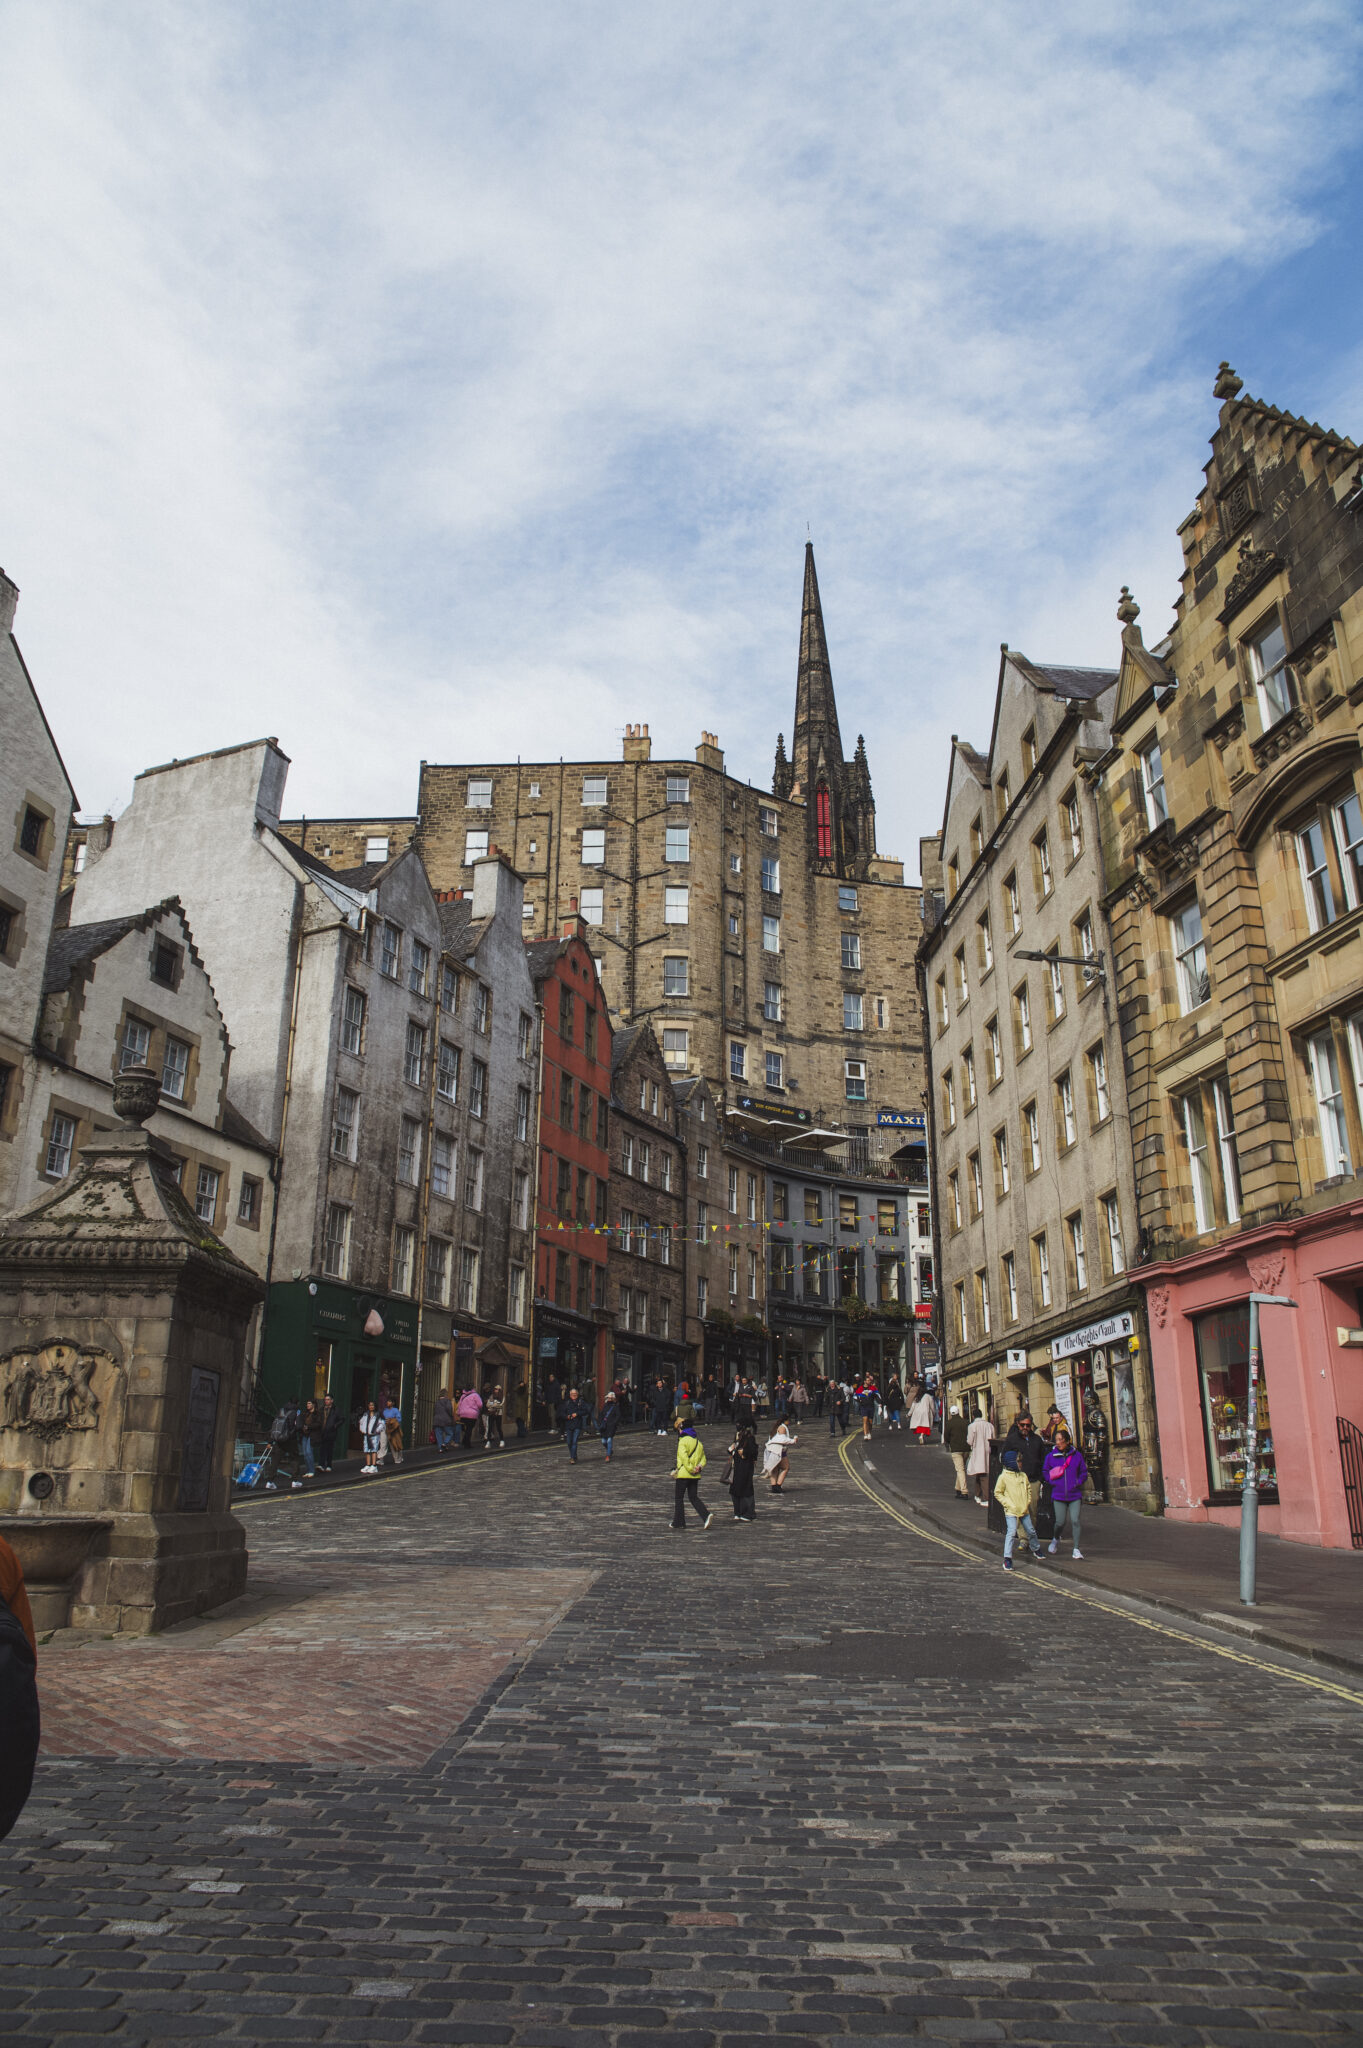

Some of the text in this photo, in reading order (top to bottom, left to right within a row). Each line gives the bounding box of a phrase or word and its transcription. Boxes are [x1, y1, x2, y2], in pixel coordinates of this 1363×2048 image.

[1064, 1319, 1117, 1350] The Knights Vault
